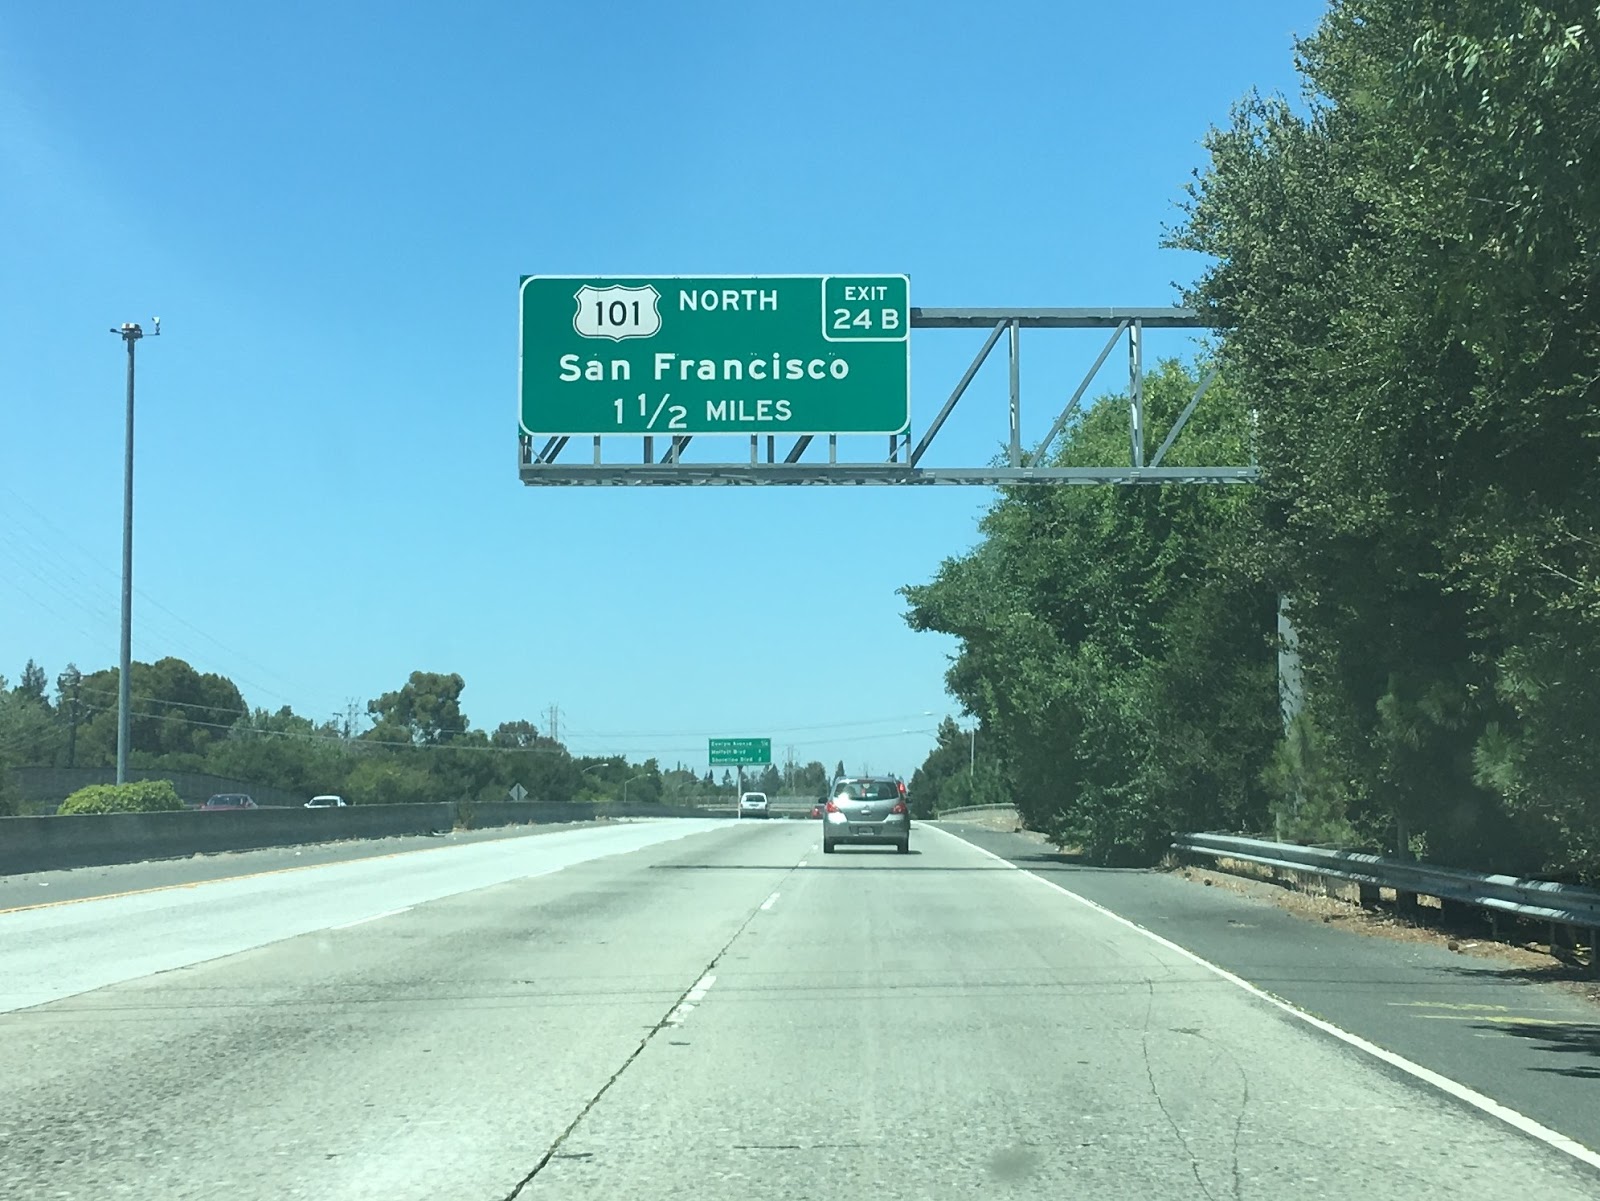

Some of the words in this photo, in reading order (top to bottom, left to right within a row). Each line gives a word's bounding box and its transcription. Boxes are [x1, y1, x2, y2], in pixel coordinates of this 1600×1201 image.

[845, 286, 888, 301] EXIT
[595, 300, 640, 326] 101
[678, 290, 778, 311] NORTH
[833, 308, 873, 330] 24
[881, 308, 900, 330] B
[559, 353, 631, 382] San
[654, 352, 850, 382] Francisco
[613, 398, 624, 424] 1
[706, 400, 792, 421] MILES
